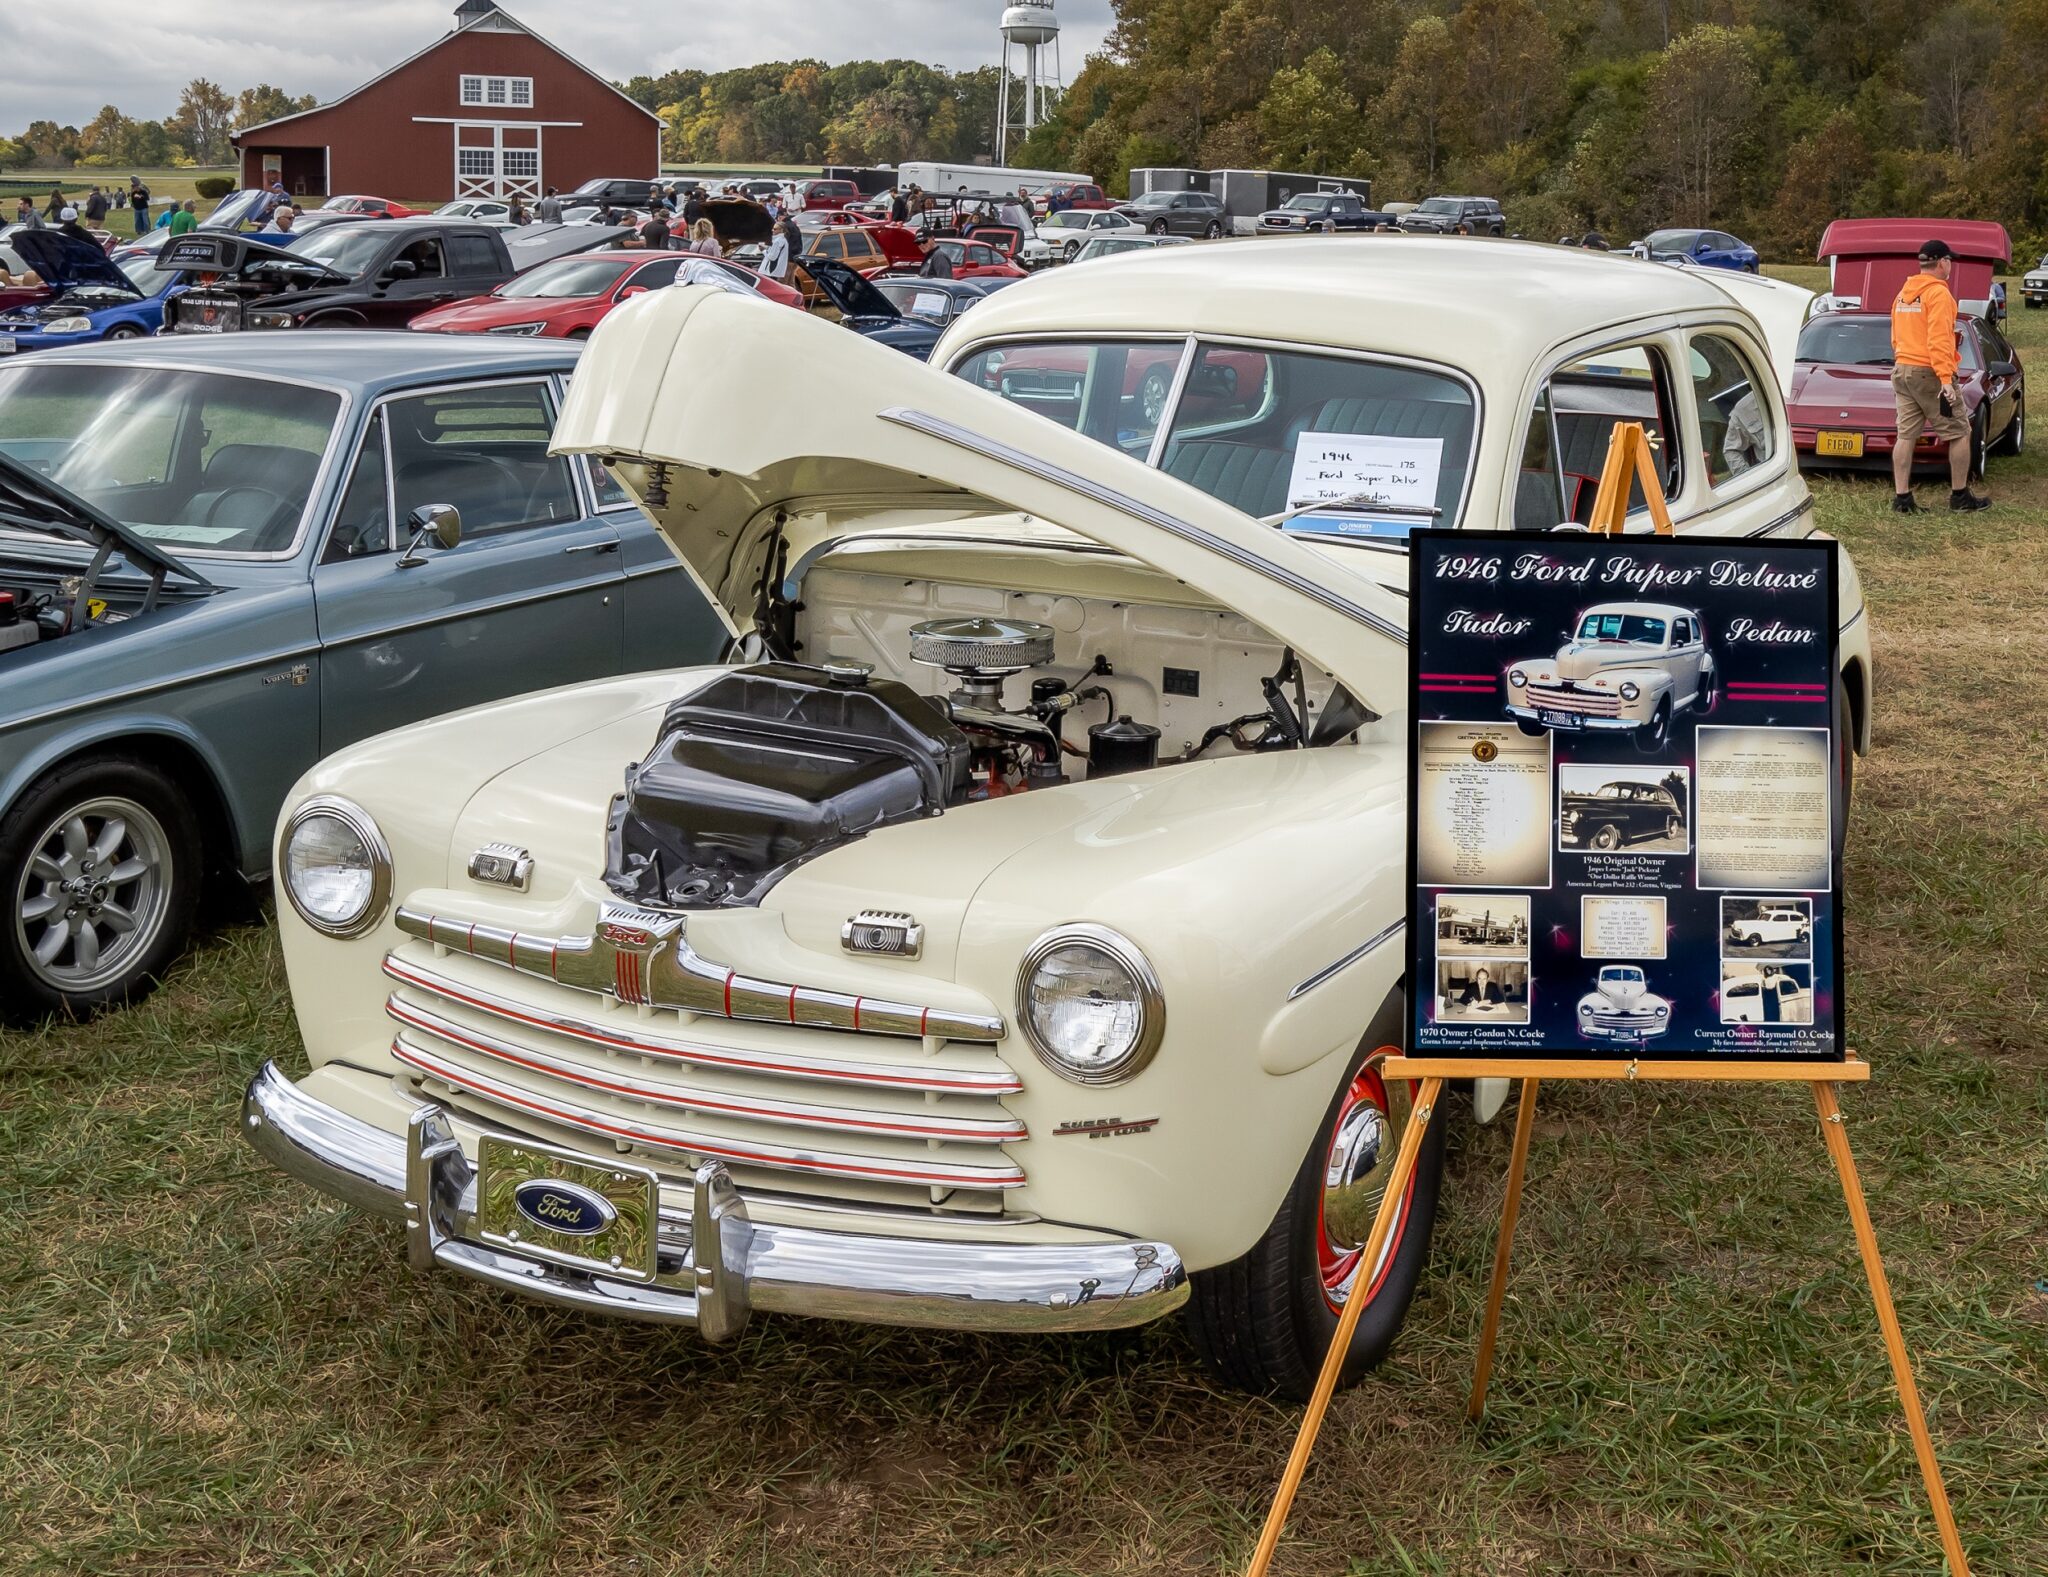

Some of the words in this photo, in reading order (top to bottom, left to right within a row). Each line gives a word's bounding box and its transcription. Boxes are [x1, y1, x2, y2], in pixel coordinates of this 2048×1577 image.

[193, 324, 223, 333] DODGE
[1827, 438, 1854, 451] FIERO
[1399, 461, 1416, 469] 175
[1319, 470, 1343, 480] Ford
[1354, 472, 1385, 486] Super
[1435, 556, 1502, 580] 1946
[1510, 553, 1597, 582] Ford
[1600, 556, 1702, 593] Super
[1708, 559, 1818, 590] Deluxe
[1443, 609, 1532, 636] Tudor
[1725, 617, 1814, 645] Sedan
[264, 673, 292, 684] VOLVO
[1583, 856, 1602, 865] 1946
[1603, 855, 1637, 867] Original
[1638, 856, 1667, 866] Owner
[1660, 882, 1682, 890] Virginia
[603, 923, 650, 945] Ford
[1419, 1028, 1439, 1037] 1970
[1439, 1027, 1468, 1037] Owner
[1473, 1028, 1506, 1038] Gordon
[1507, 1028, 1518, 1038] N.
[1519, 1029, 1546, 1039] Cocke
[1694, 1029, 1726, 1039] Current
[1726, 1028, 1758, 1039] Owner:
[1758, 1029, 1797, 1041] Raymond
[1797, 1030, 1809, 1039] O.
[1473, 1038, 1503, 1047] Implement
[1503, 1039, 1531, 1047] Company,
[1713, 1039, 1722, 1047] My
[537, 1193, 582, 1224] Ford
